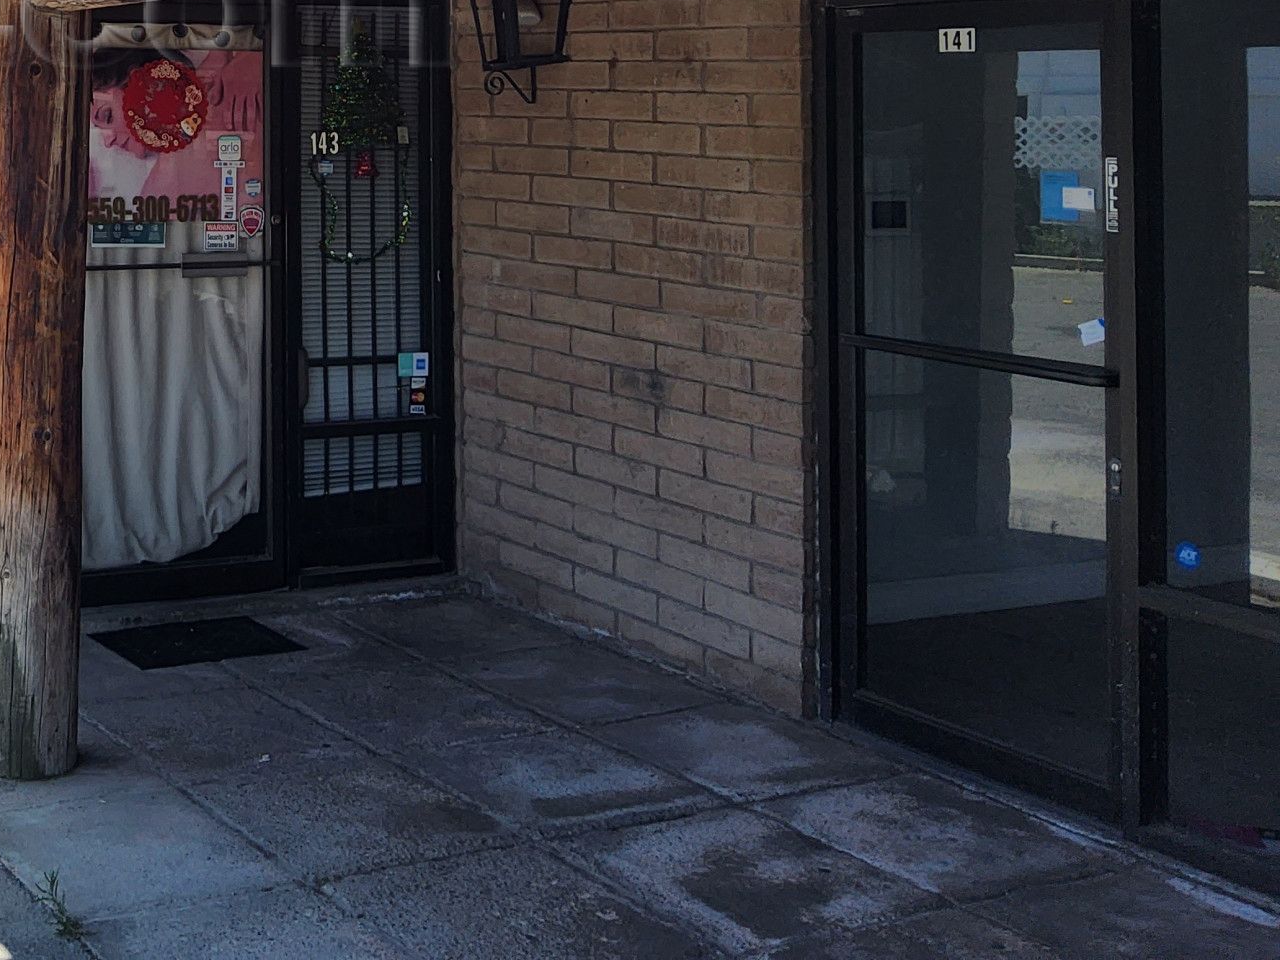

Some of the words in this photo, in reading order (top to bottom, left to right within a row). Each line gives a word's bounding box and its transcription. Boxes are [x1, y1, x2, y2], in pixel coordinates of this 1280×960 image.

[943, 30, 972, 51] 141
[220, 141, 240, 152] arlo
[310, 131, 339, 155] 143
[1108, 163, 1118, 211] PULL
[88, 194, 219, 225] 559-300-6713
